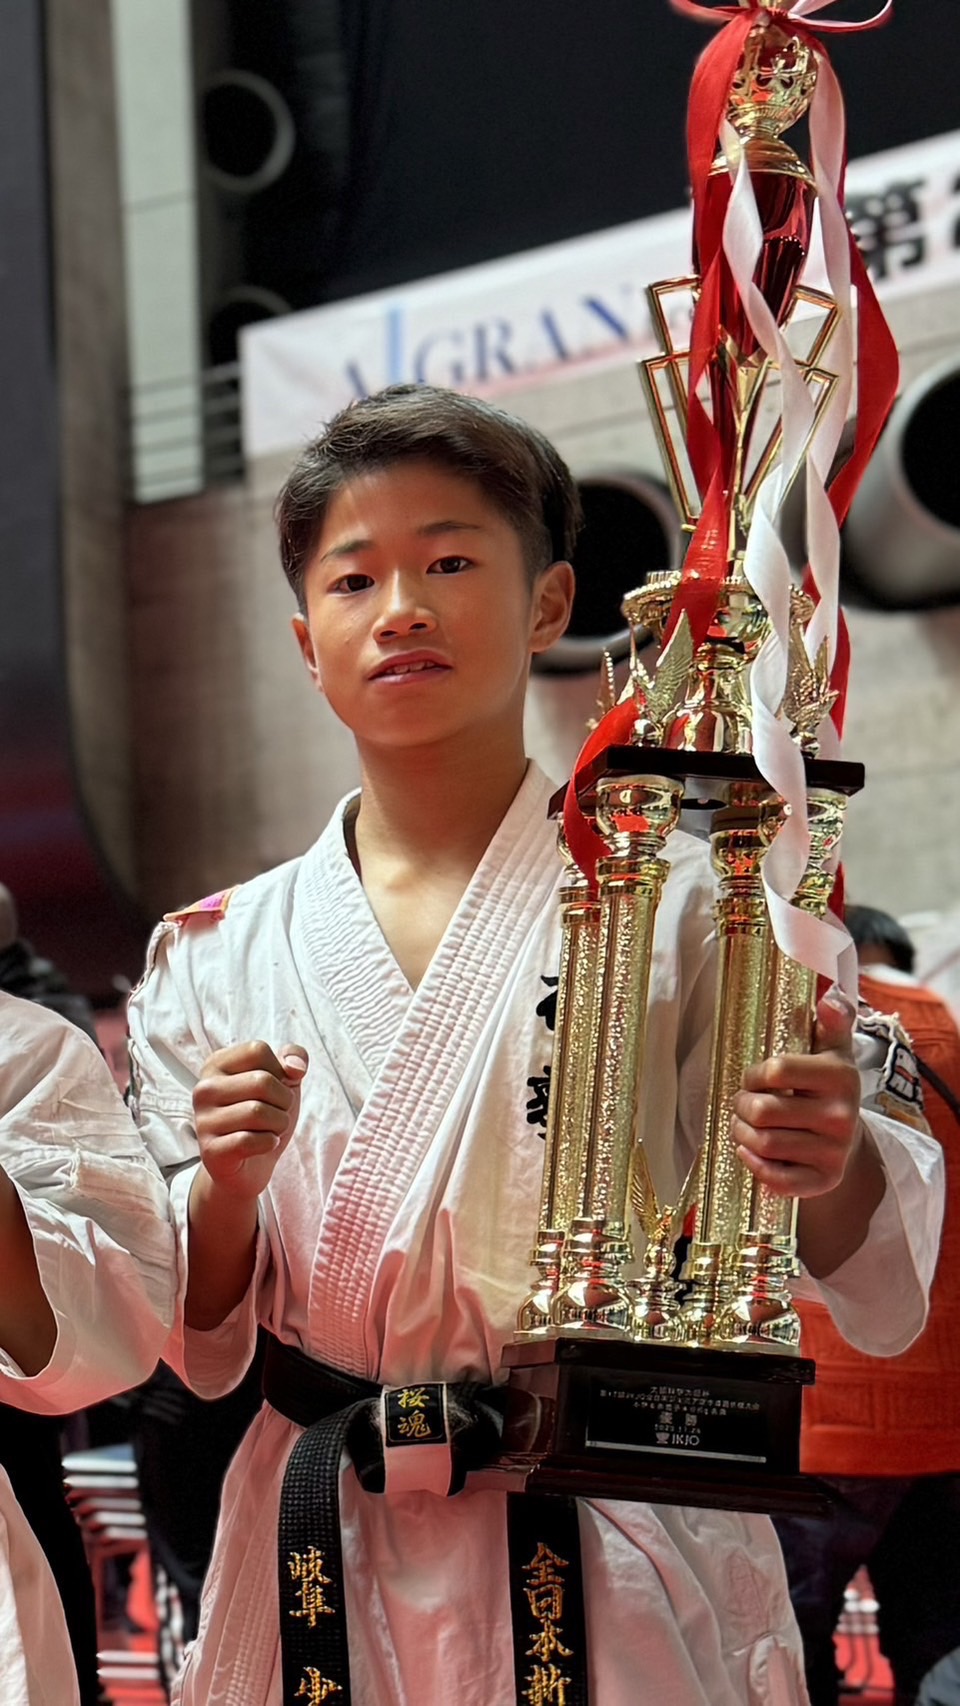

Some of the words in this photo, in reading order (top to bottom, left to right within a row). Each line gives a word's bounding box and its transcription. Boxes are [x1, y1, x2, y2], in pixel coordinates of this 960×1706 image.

[397, 1386, 433, 1439] 桜魂
[671, 1433, 701, 1447] JKJO
[287, 1545, 336, 1629] 岐阜
